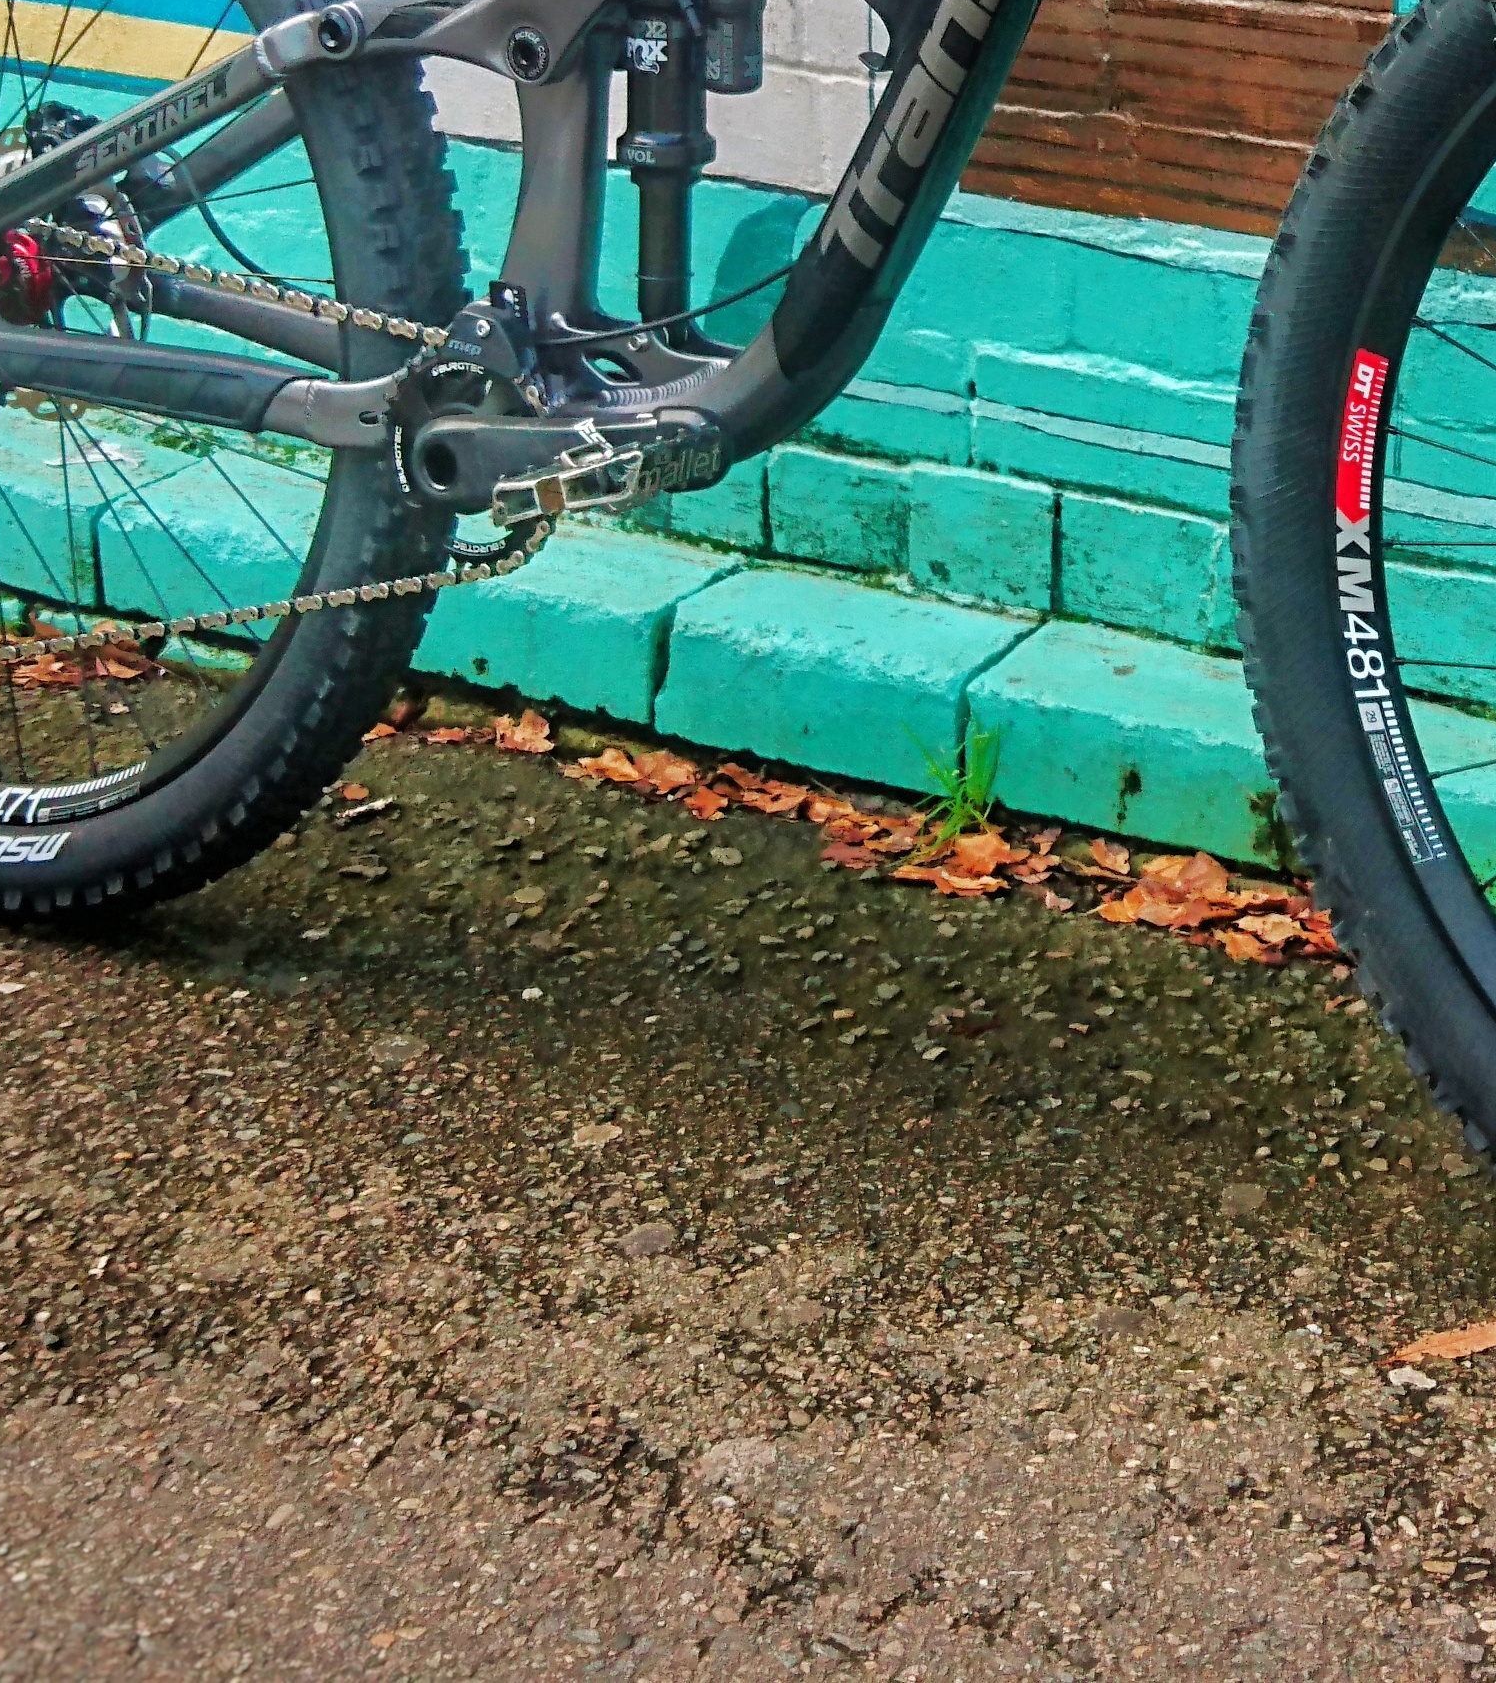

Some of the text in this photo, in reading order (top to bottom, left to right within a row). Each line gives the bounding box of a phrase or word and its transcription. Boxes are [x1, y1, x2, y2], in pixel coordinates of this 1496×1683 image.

[627, 148, 655, 164] VOL
[1335, 362, 1392, 699] DT SWISS XM481
